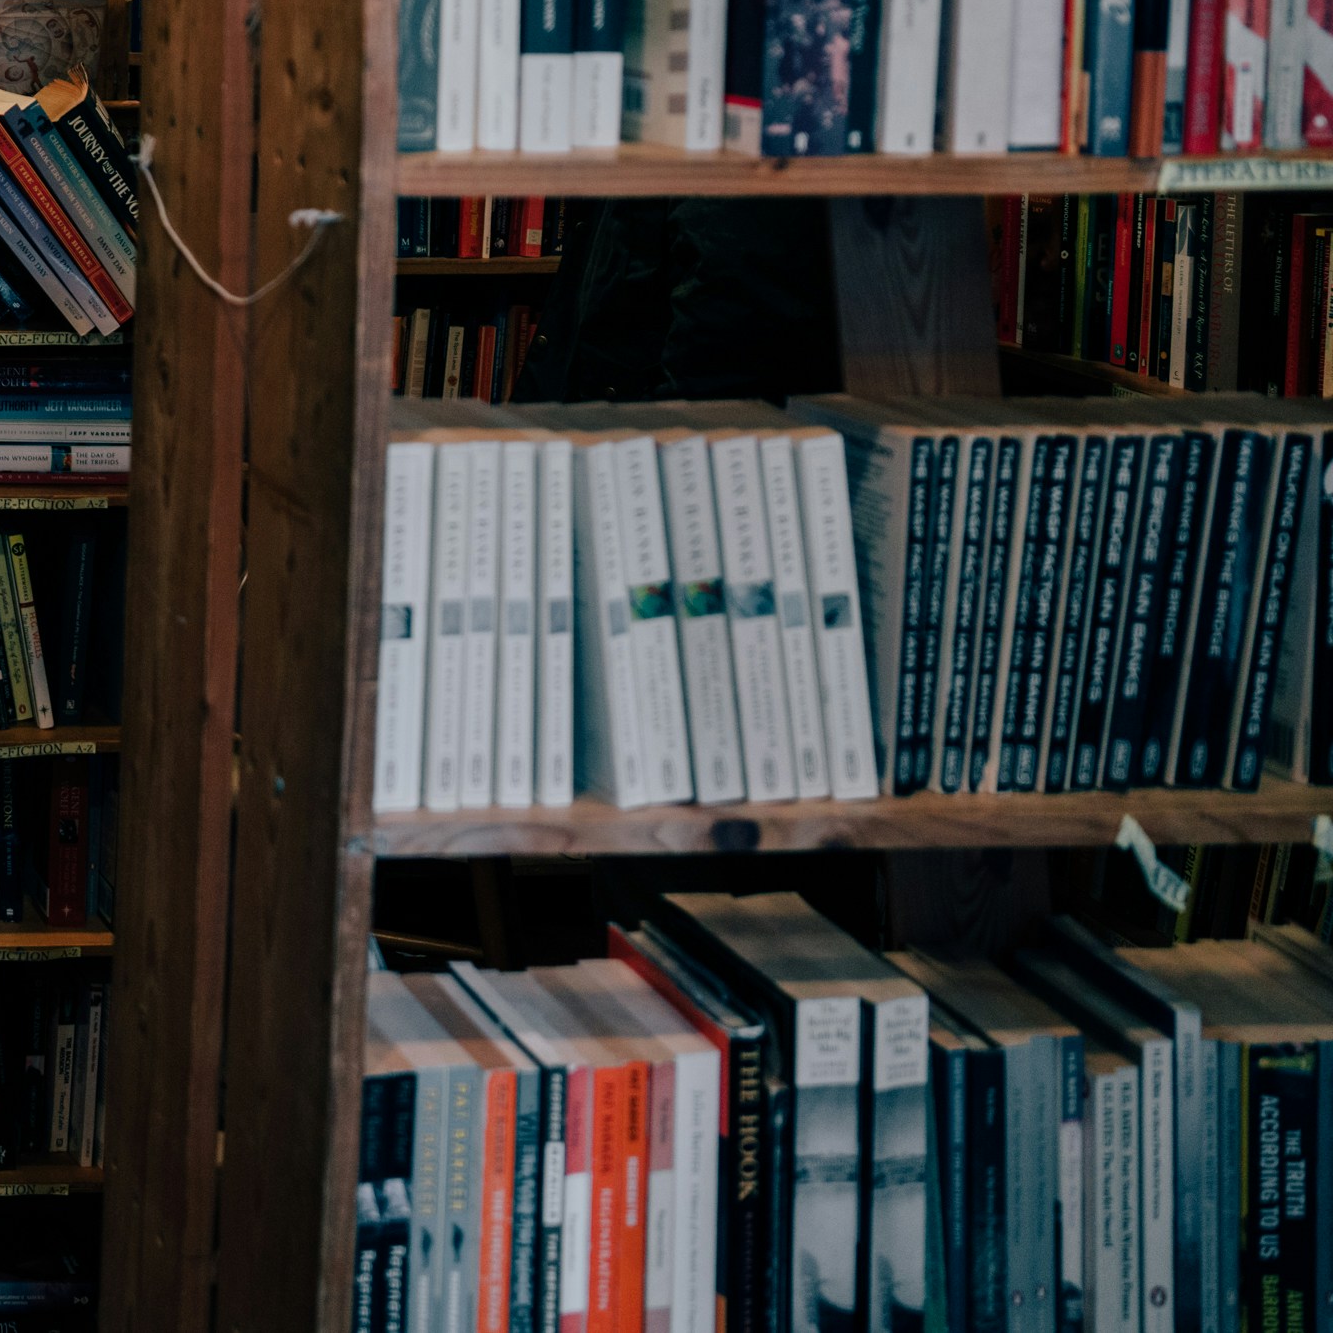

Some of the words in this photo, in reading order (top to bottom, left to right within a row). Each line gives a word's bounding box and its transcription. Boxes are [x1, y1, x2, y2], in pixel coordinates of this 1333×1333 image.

[66, 115, 106, 164] JOURNEY
[106, 174, 127, 197] THE
[33, 186, 74, 240] STEAMPUNK
[15, 240, 37, 264] DAVID
[32, 262, 48, 279] DAY
[1223, 223, 1236, 273] LETTERS
[1223, 276, 1233, 294] OF
[45, 401, 64, 412] JEFF
[68, 400, 122, 412] VANDERMEER
[87, 499, 106, 507] A-Z
[1280, 442, 1306, 528] WALKING
[1263, 561, 1288, 625] GLASS
[1256, 629, 1276, 667] IAIN
[1245, 671, 1270, 739] BANKS
[73, 745, 93, 753] A-Z
[738, 1044, 761, 1104] THE
[735, 1115, 757, 1201] HOOK
[1257, 1094, 1281, 1202] ACCORDING
[1284, 1128, 1303, 1156] THE
[1283, 1159, 1306, 1219] TRUTH
[1259, 1206, 1280, 1229] TO
[1256, 1233, 1280, 1260] US
